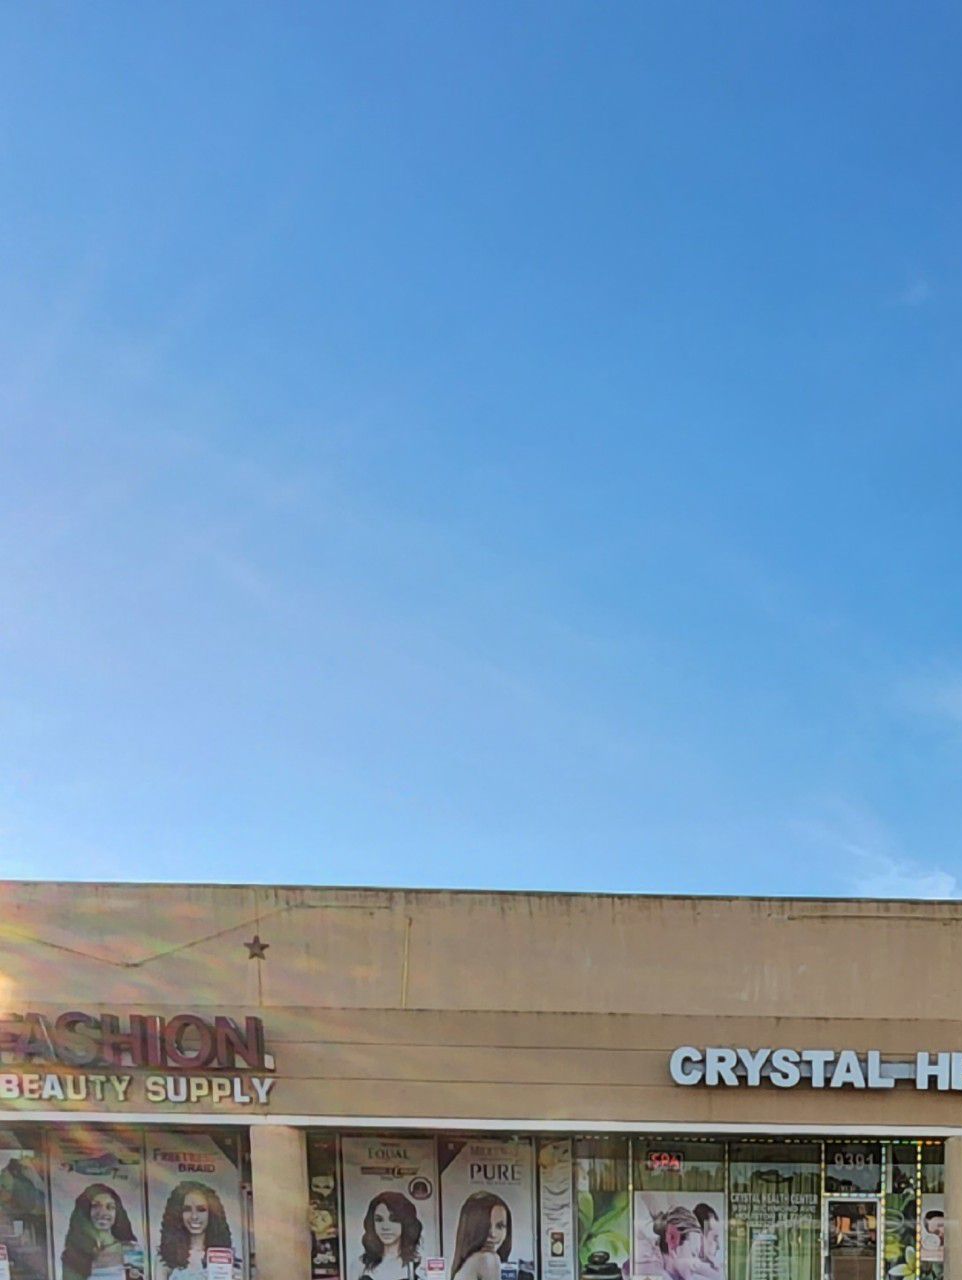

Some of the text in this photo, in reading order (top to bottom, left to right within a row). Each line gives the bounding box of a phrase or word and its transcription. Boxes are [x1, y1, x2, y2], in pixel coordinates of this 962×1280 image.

[669, 1046, 895, 1090] CRYSTAL
[1, 1074, 274, 1104] BEAUTY SUPPLY
[470, 1163, 524, 1181] PURE
[835, 1153, 874, 1170] 9391
